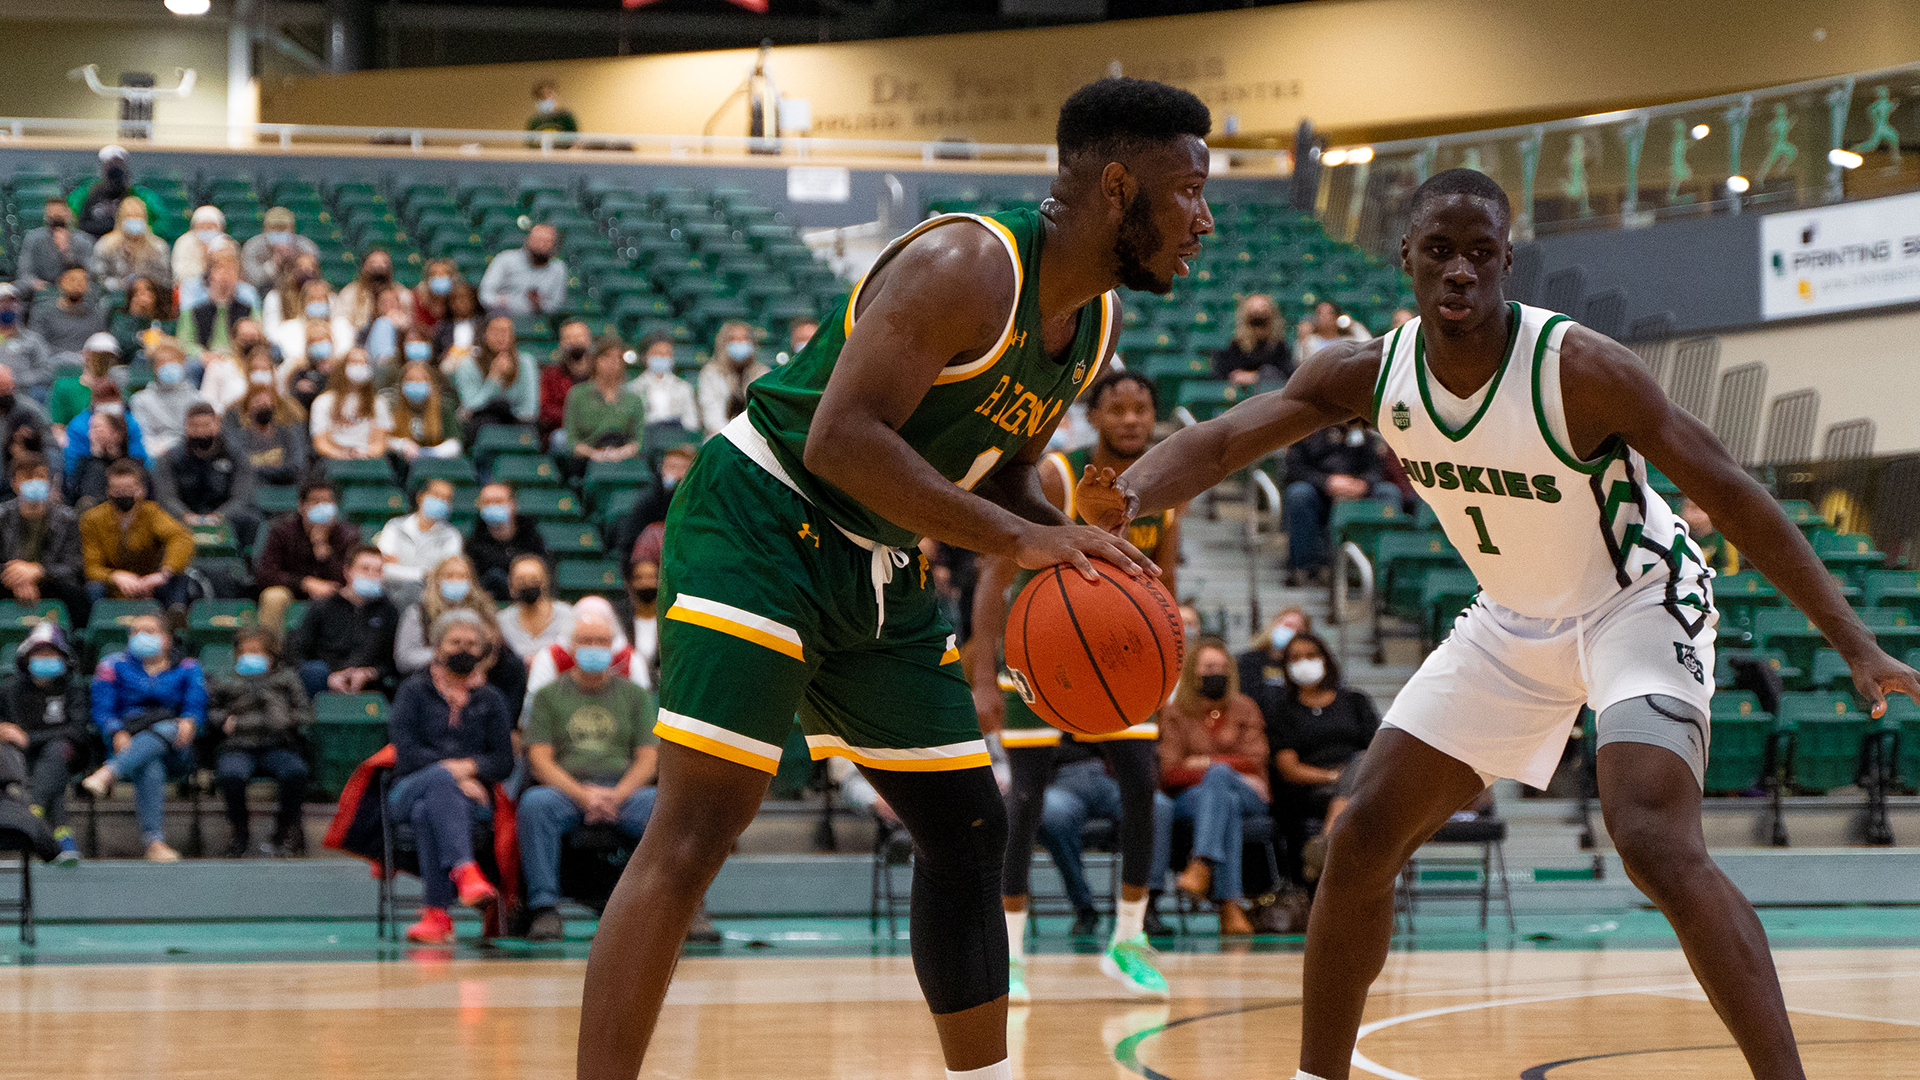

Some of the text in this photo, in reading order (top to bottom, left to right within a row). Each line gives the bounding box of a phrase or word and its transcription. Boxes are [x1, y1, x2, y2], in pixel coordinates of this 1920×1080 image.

[1794, 239, 1890, 269] PRINTING
[1401, 458, 1562, 503] HUSKIES
[1465, 506, 1501, 555] 1
